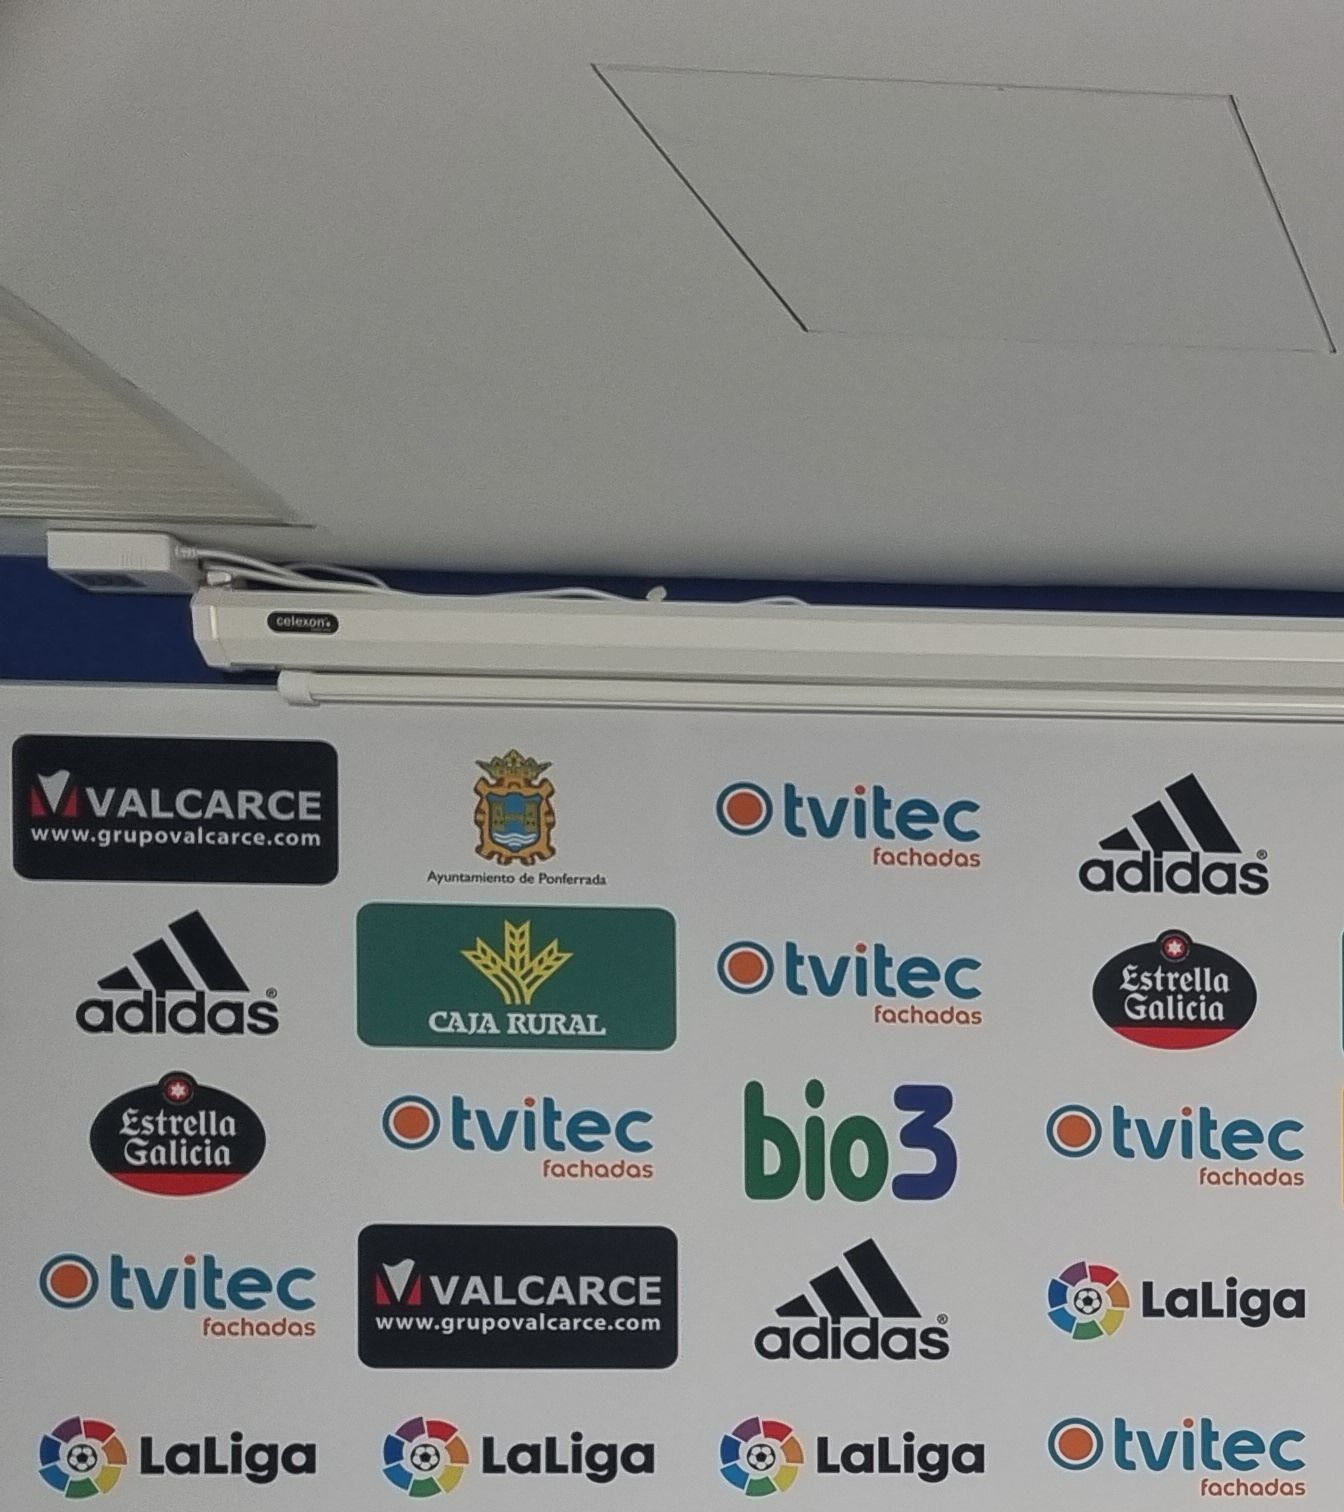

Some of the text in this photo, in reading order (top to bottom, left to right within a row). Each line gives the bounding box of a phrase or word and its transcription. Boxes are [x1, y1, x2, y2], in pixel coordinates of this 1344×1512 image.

[276, 615, 325, 628] celexon
[86, 788, 321, 820] VALCARCE
[785, 783, 980, 842] tvitec
[31, 826, 320, 847] www.grupovalcarce.com
[427, 871, 606, 885] Ayuntamiento de Ponferrada
[1079, 851, 1268, 895] adidas
[786, 942, 981, 999] tvitec
[1120, 965, 1229, 992] Estrella
[76, 989, 278, 1035] adidas
[429, 1012, 606, 1035] CAJA RURAL
[1125, 993, 1224, 1021] Galicia
[120, 1108, 236, 1136] Estrella
[452, 1096, 653, 1152] tvitec
[745, 1079, 957, 1202] bio3
[1113, 1106, 1304, 1161] tvitec
[124, 1138, 230, 1166] Galicia
[544, 1160, 653, 1178] fachadas
[1200, 1167, 1304, 1185] fachadas
[111, 1254, 315, 1310] tvitec
[430, 1276, 661, 1305] VALCARCE
[1143, 1277, 1305, 1327] LaLiga
[376, 1313, 660, 1334] www.grupovalcarce.com
[755, 1318, 949, 1360] adidas
[141, 1431, 316, 1484] LaLiga
[483, 1432, 654, 1483] LaLiga
[818, 1432, 984, 1482] LaLiga
[1115, 1418, 1305, 1471] tvitec
